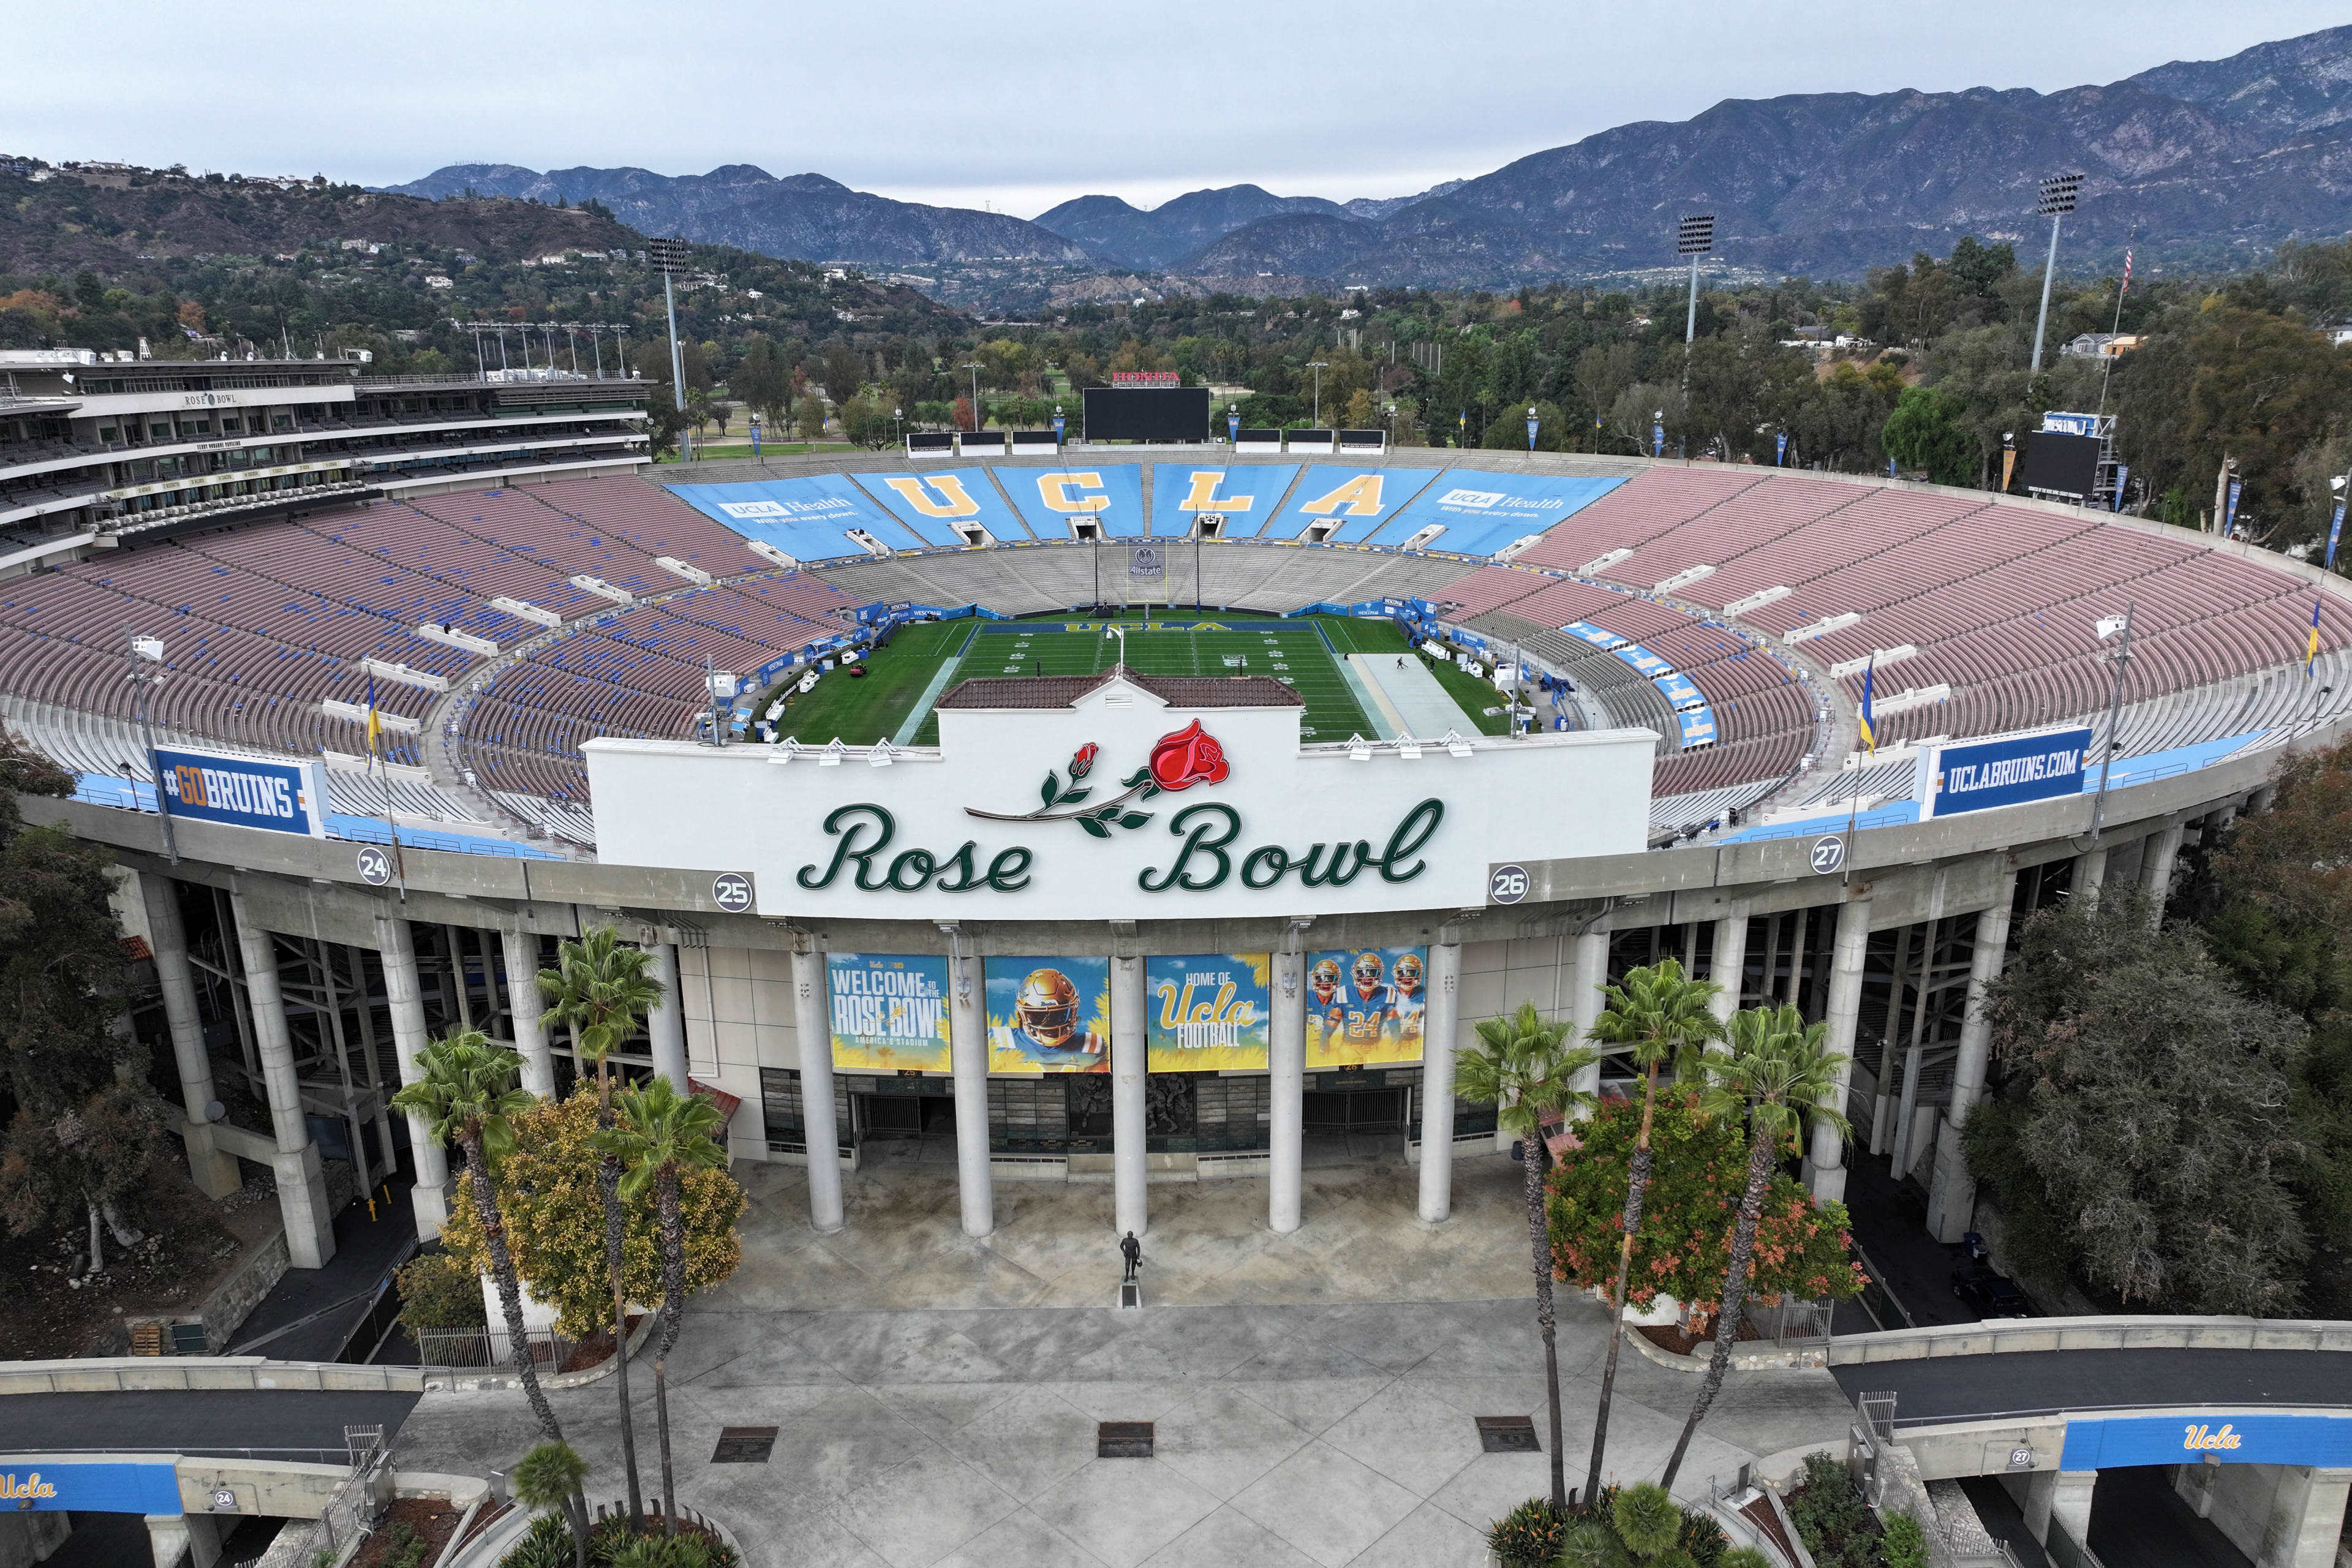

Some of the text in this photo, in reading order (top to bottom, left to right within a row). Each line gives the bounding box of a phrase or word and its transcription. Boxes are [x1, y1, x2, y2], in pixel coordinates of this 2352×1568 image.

[1113, 372, 1181, 381] HONDA
[185, 394, 236, 405] ROSE BOWL
[731, 497, 854, 514] UCLA Health
[1450, 493, 1564, 509] UCLA Health
[1130, 566, 1161, 575] Allstate
[1065, 622, 1232, 631] UCLA
[1949, 748, 2079, 794] UCLABRUINS.COM
[163, 765, 294, 818] #GOBRUINS
[796, 797, 1445, 893] Rose Bowl
[1814, 844, 1841, 866] 27
[361, 856, 386, 877] 24
[717, 882, 747, 903] 25
[1494, 874, 1525, 895] 26
[832, 970, 937, 997] WELCOME TO
[1186, 971, 1231, 986] HOME OF
[929, 989, 940, 998] THE
[834, 995, 886, 1036] ROSE
[1158, 981, 1256, 1030] Ucla
[1348, 1011, 1381, 1038] 24
[855, 1036, 929, 1047] AMERICA'S STADIUM
[1177, 1022, 1240, 1049] FOOTBALL
[2184, 1424, 2242, 1449] Ucla
[2015, 1452, 2027, 1461] 27
[218, 1494, 230, 1502] 24
